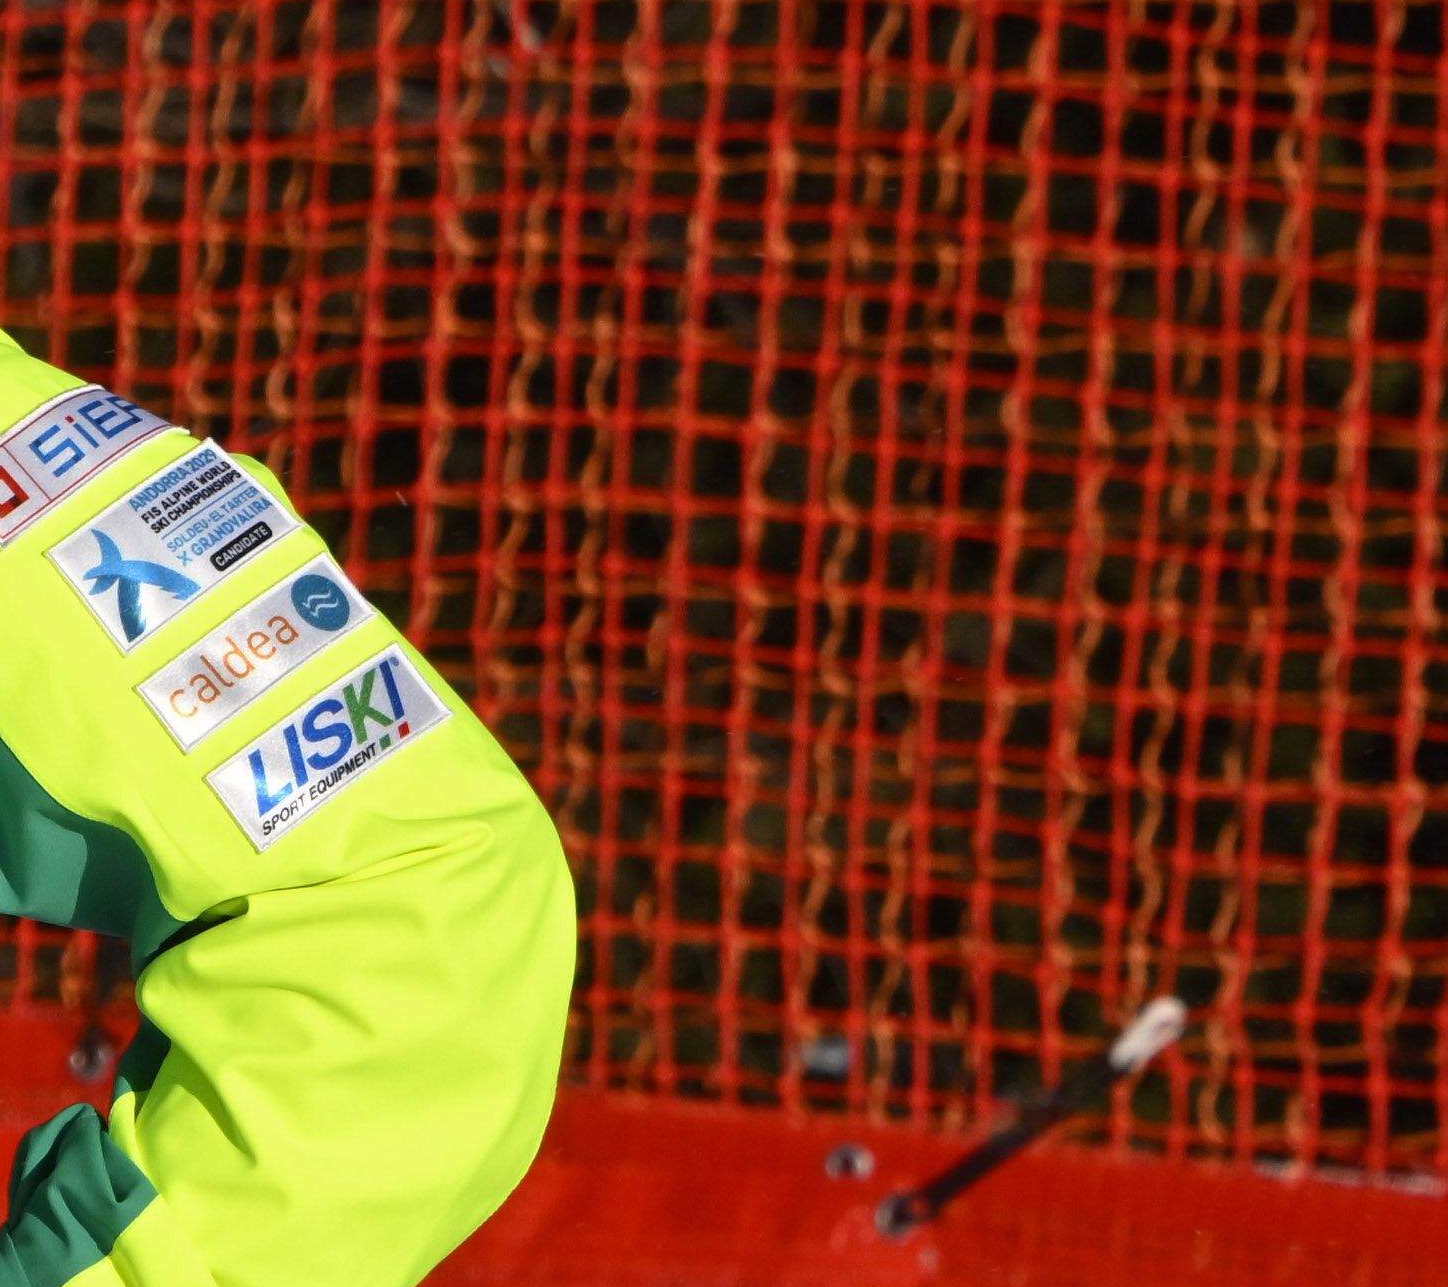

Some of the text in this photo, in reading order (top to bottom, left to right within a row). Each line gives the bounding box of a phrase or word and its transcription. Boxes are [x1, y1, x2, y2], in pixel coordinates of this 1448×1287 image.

[128, 448, 218, 511] ANDORRA 2029
[141, 461, 232, 524] FIS ALPINE WORLD
[150, 469, 242, 534] SKI CHAMPIONSHIPS
[191, 497, 274, 556] GRANDVALIRA
[215, 525, 269, 566] CANDIDATE
[169, 614, 300, 719] caldea
[248, 659, 406, 818] LISKI
[262, 742, 379, 837] SPORT EQUIPMENT
